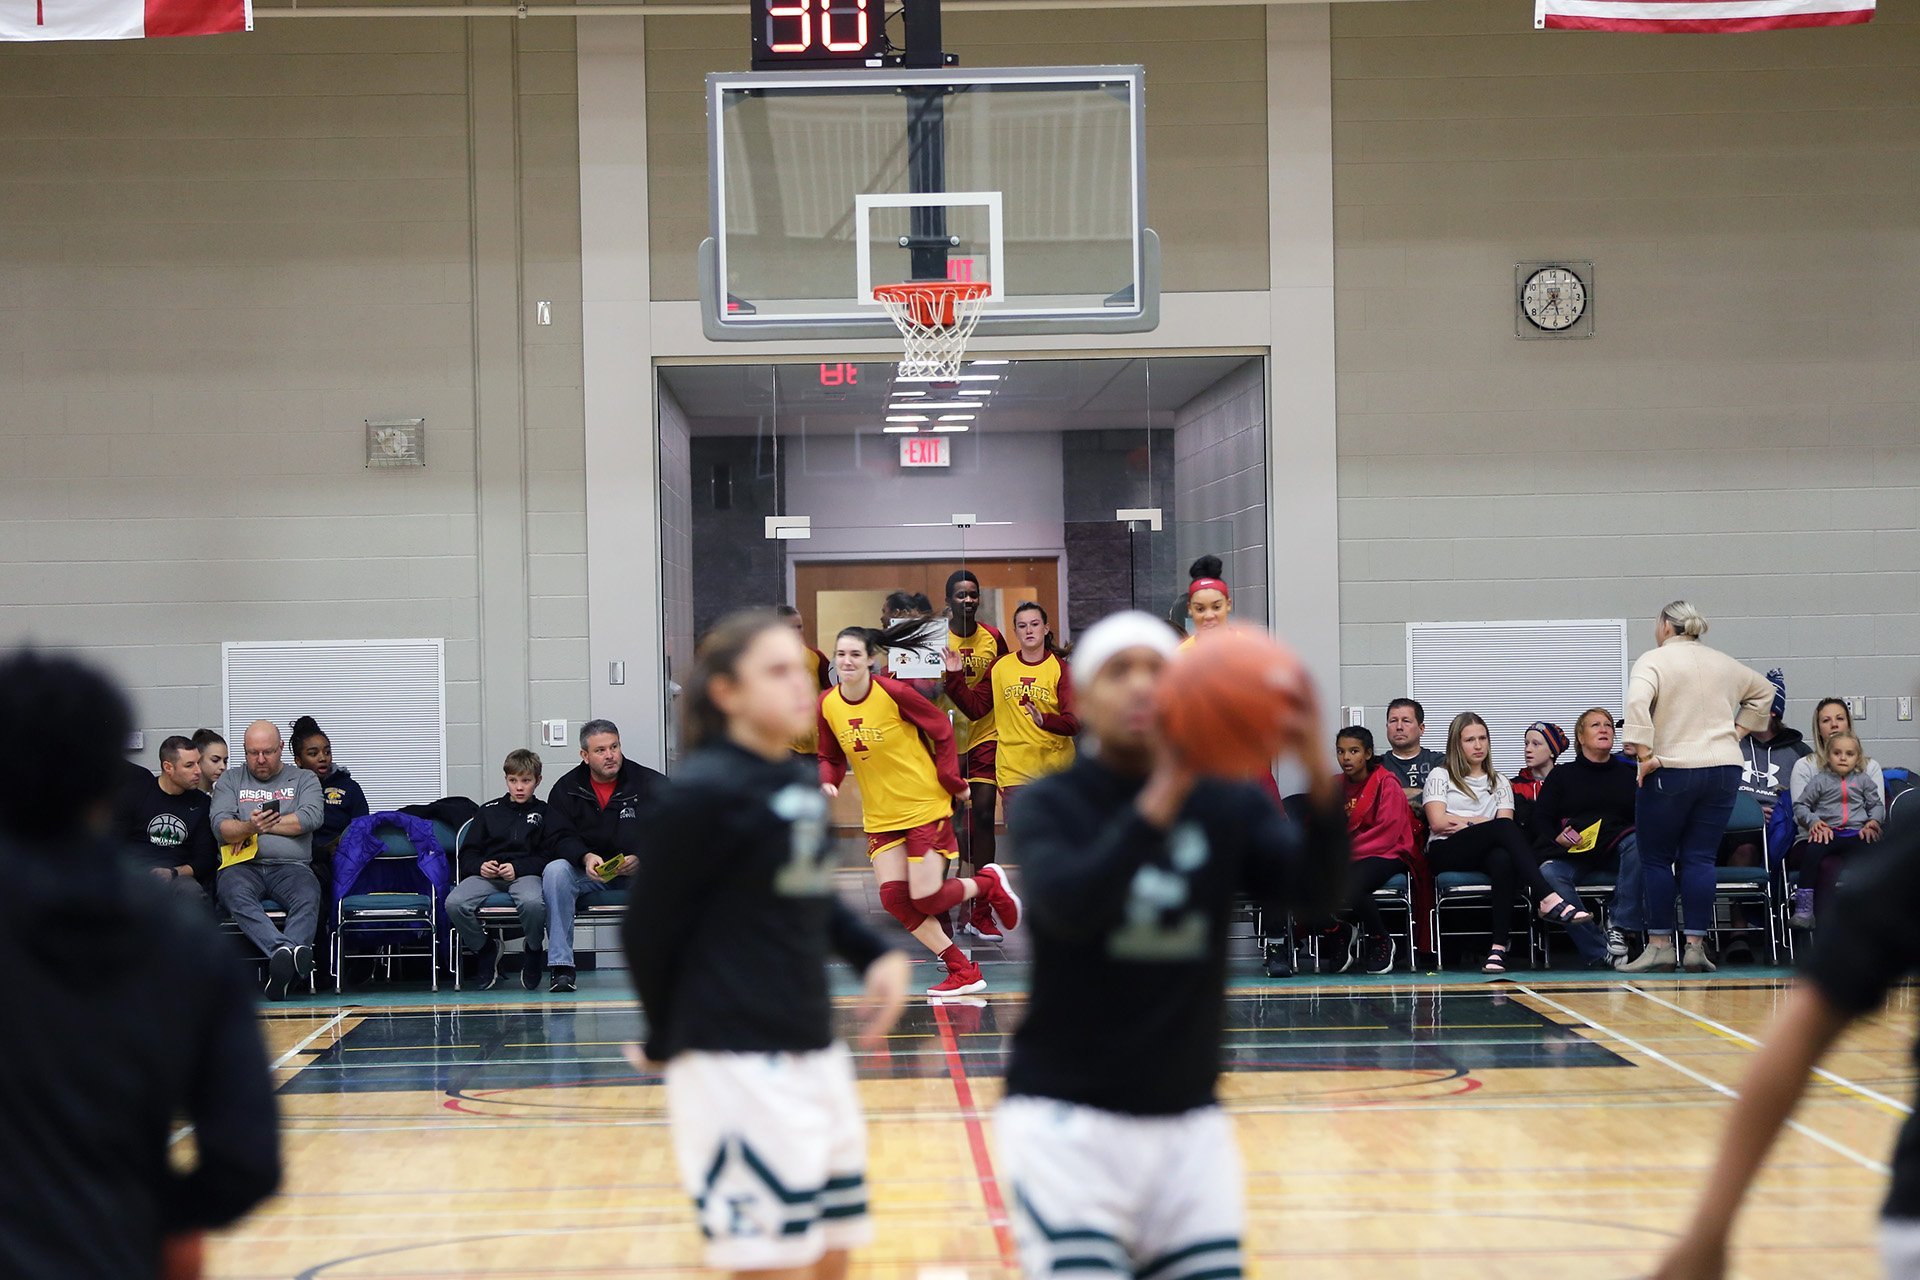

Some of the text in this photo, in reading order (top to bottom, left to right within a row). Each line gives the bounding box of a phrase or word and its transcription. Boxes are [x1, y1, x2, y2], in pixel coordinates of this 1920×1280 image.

[768, 0, 868, 53] 30
[909, 439, 941, 464] EXIT
[1004, 684, 1050, 703] STATE
[839, 728, 885, 747] STATE
